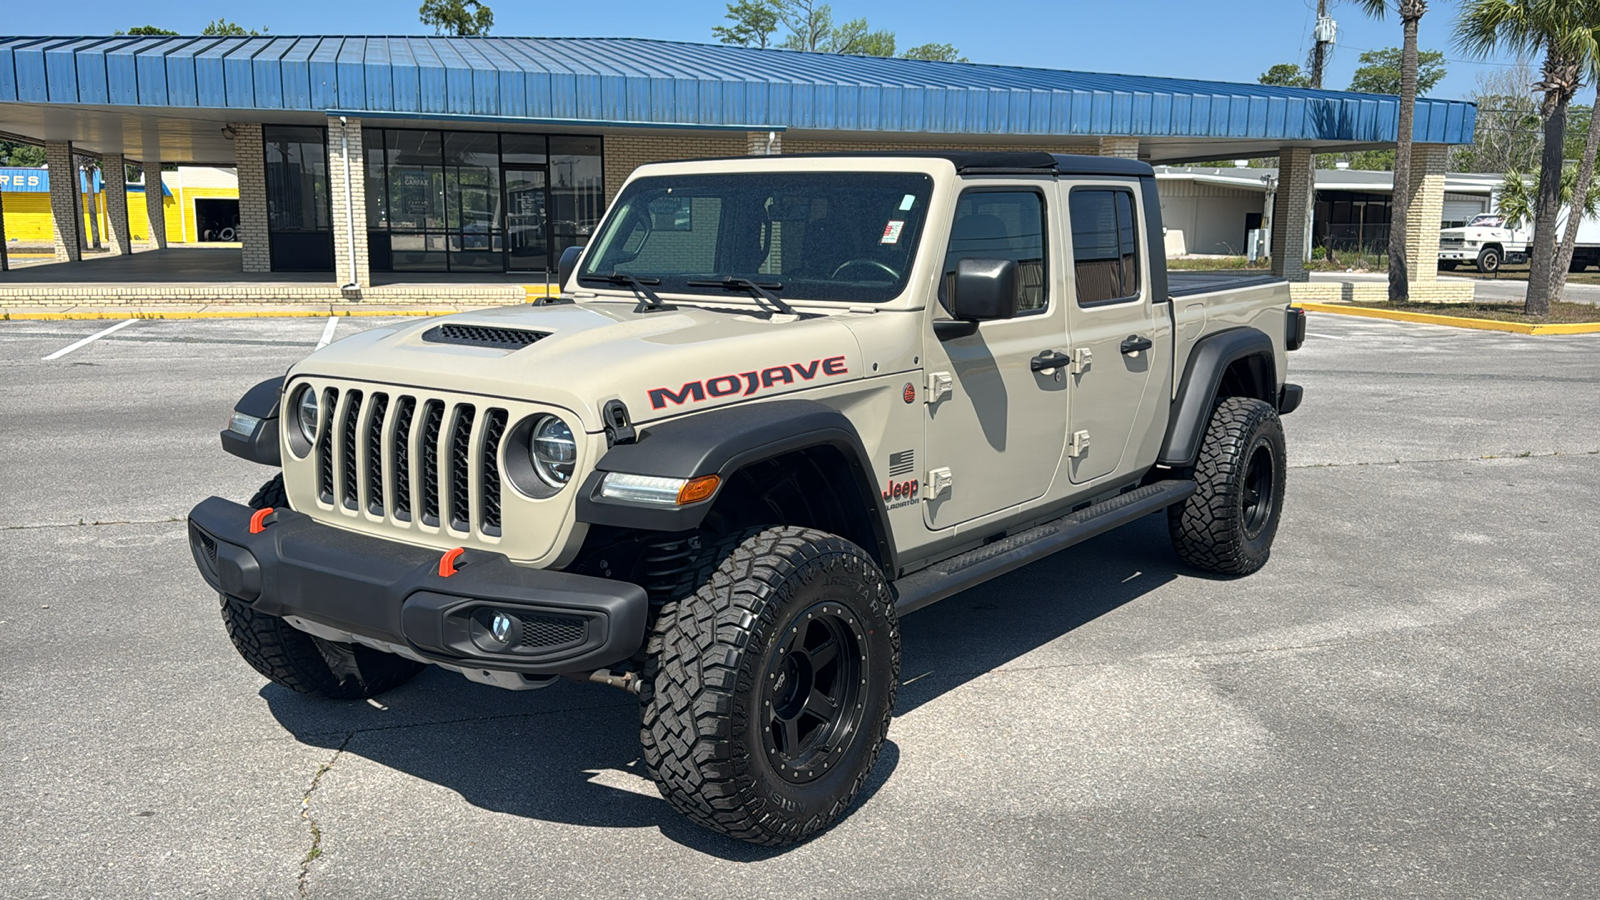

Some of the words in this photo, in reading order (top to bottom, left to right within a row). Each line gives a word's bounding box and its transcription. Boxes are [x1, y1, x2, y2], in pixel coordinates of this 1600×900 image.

[646, 355, 848, 411] MOJAVE
[882, 479, 919, 502] Jeep
[885, 498, 920, 511] LADIATOR
